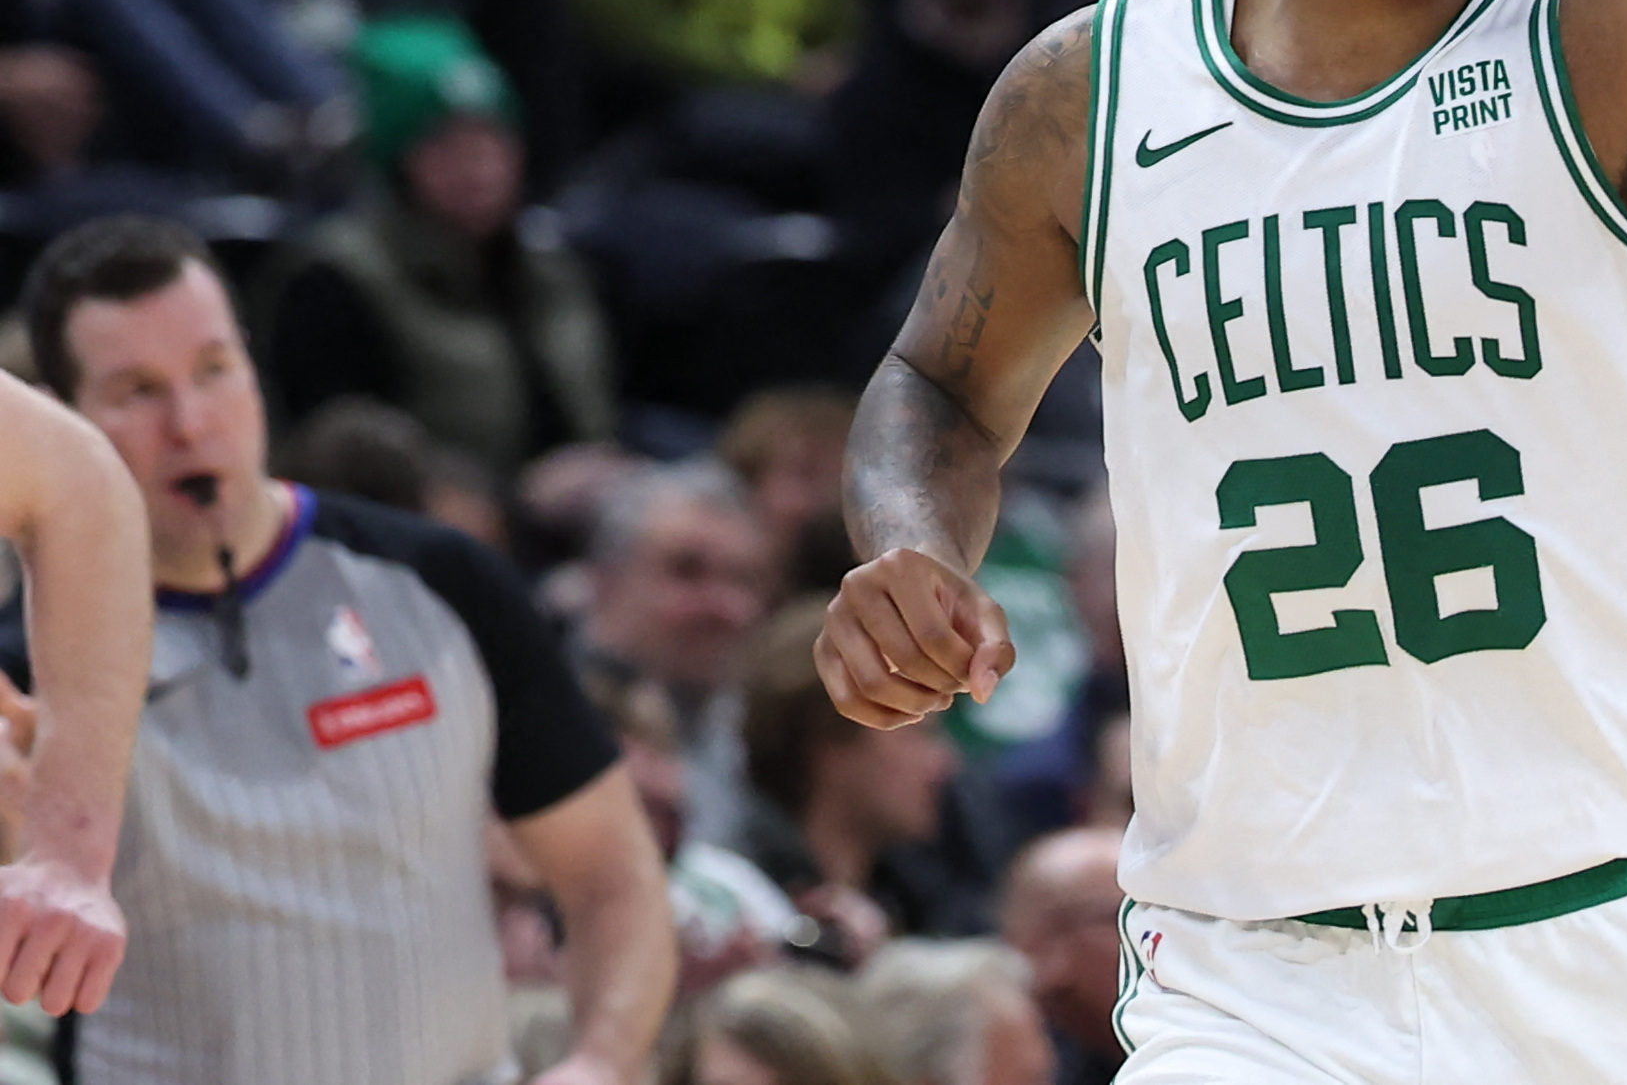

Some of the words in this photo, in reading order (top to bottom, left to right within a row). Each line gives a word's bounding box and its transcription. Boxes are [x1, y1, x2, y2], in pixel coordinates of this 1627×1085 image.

[1428, 59, 1511, 107] VISTA
[1433, 92, 1513, 135] PRINT
[1144, 199, 1542, 422] CELTICS
[1216, 429, 1546, 680] 26
